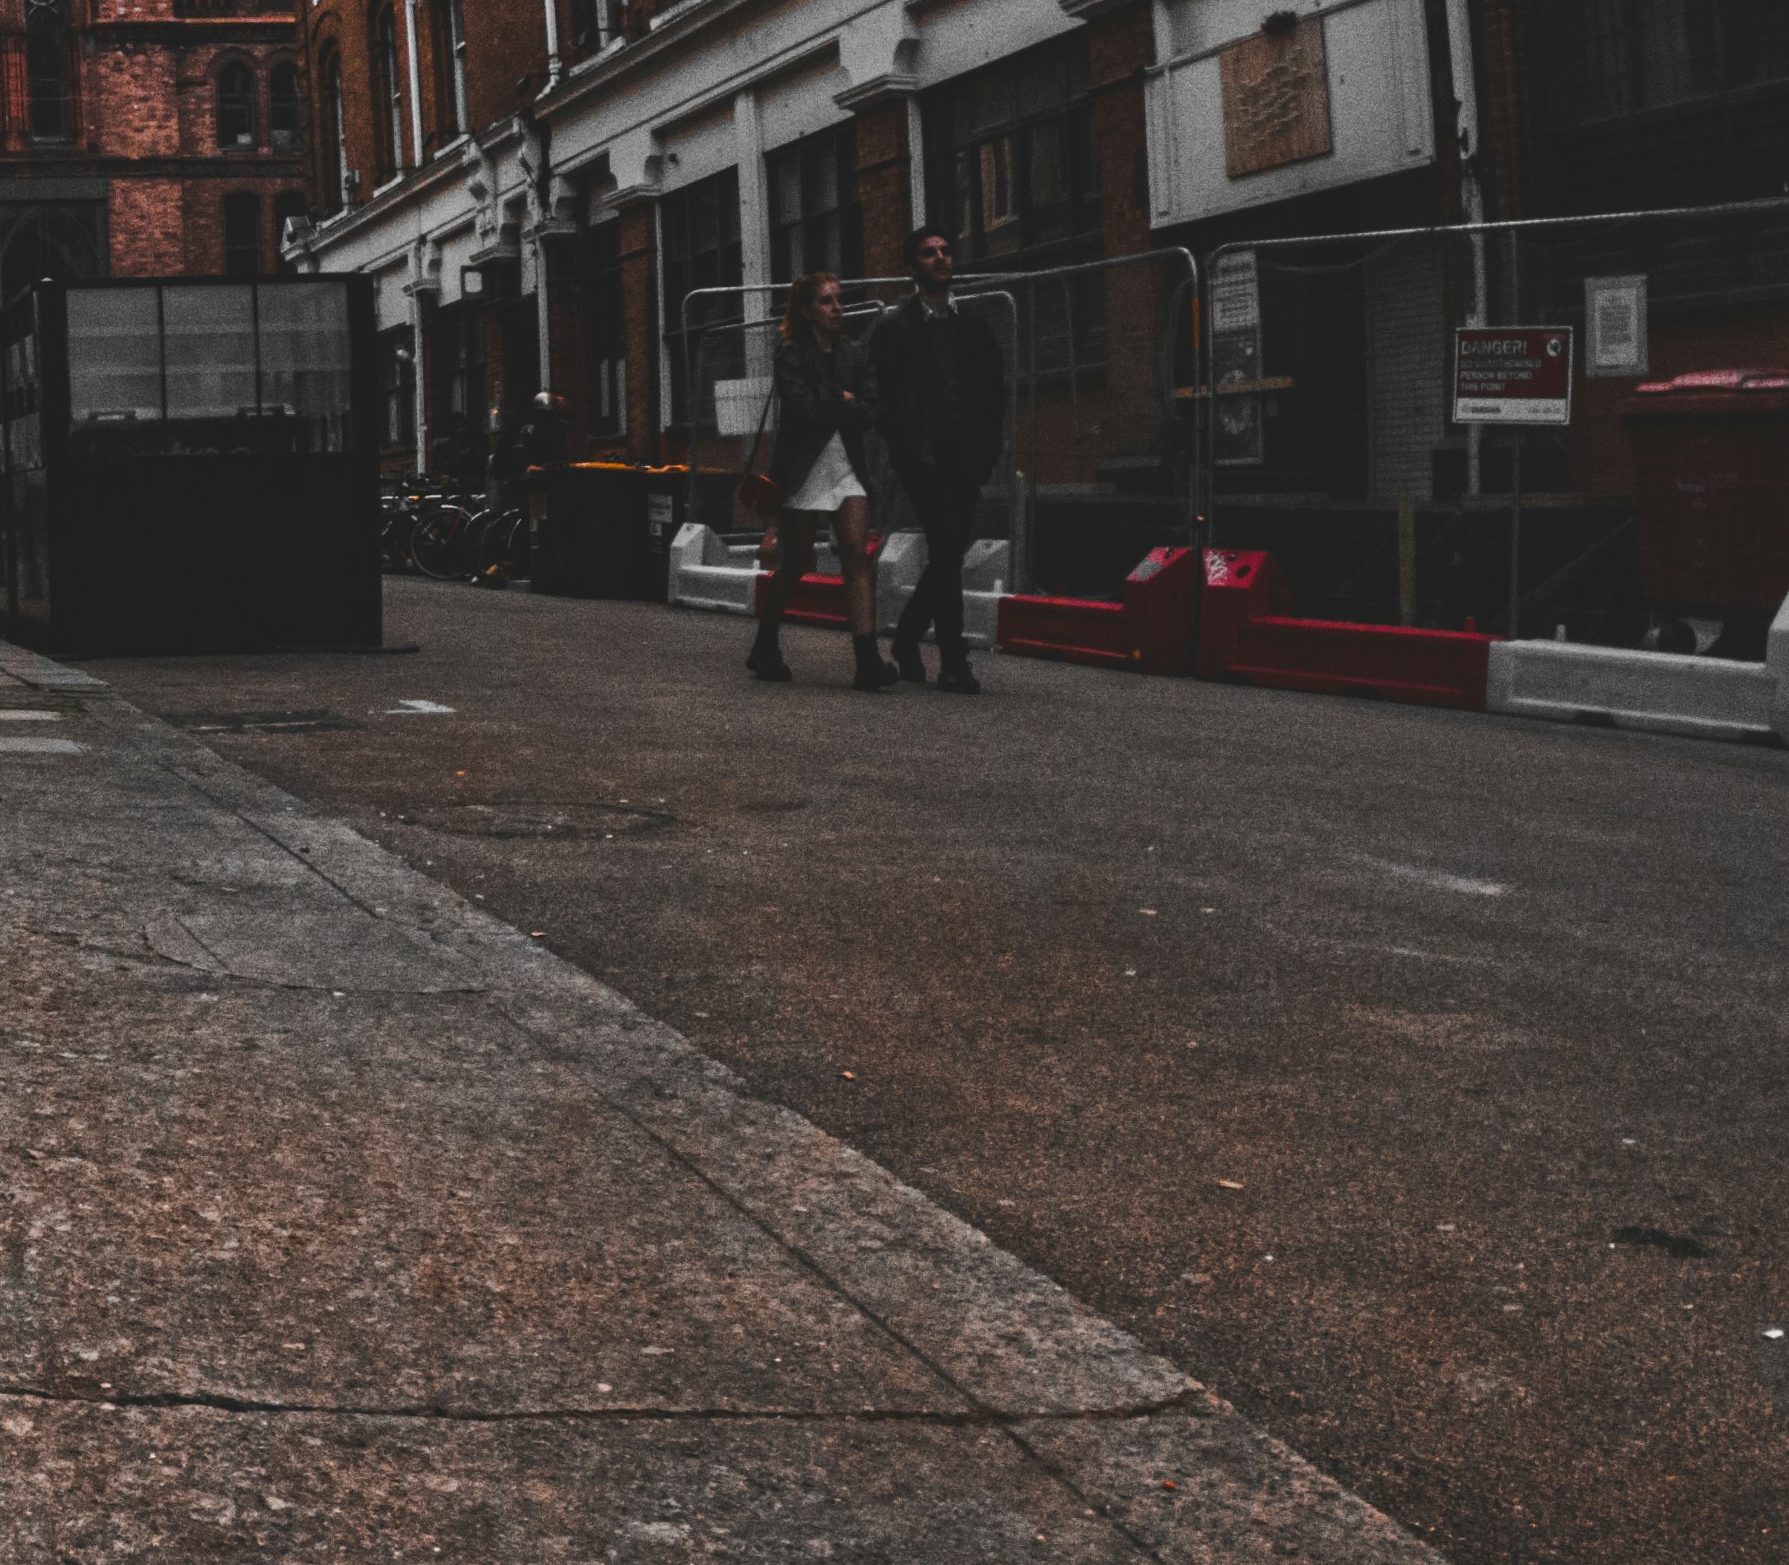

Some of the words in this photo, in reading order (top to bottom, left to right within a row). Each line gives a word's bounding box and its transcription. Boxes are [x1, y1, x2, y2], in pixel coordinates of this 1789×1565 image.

[1462, 339, 1527, 355] DANGER!
[1461, 382, 1479, 391] THIS
[1481, 382, 1505, 391] POINT
